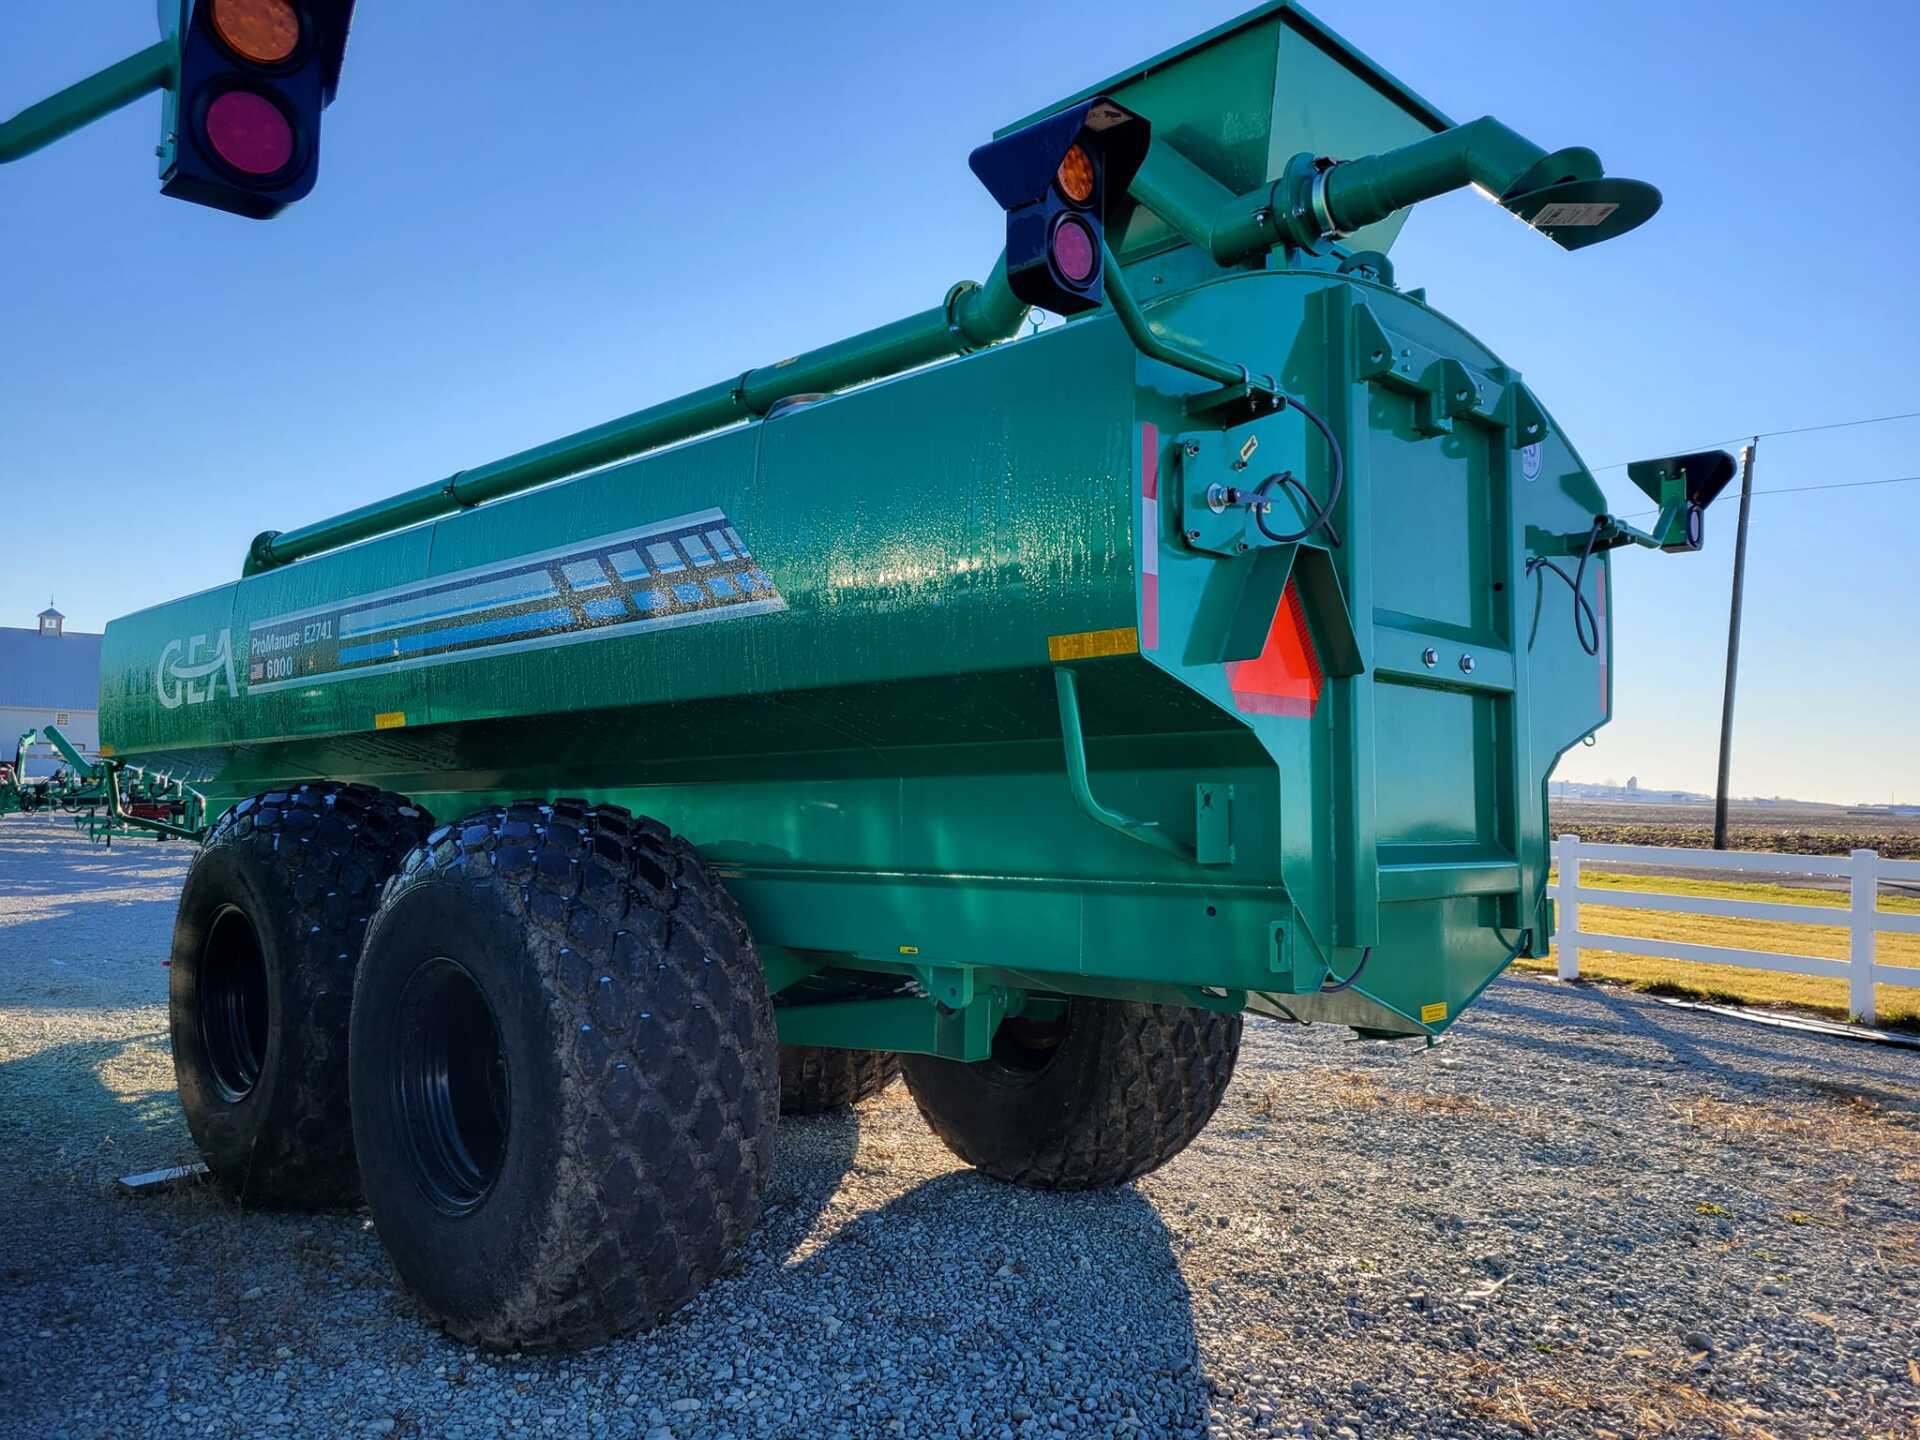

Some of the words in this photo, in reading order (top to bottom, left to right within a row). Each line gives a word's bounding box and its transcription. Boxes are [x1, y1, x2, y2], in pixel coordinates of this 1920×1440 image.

[252, 630, 300, 655] ProManure
[304, 620, 332, 643] E2741
[157, 628, 239, 709] GEA
[266, 656, 293, 679] 6000
